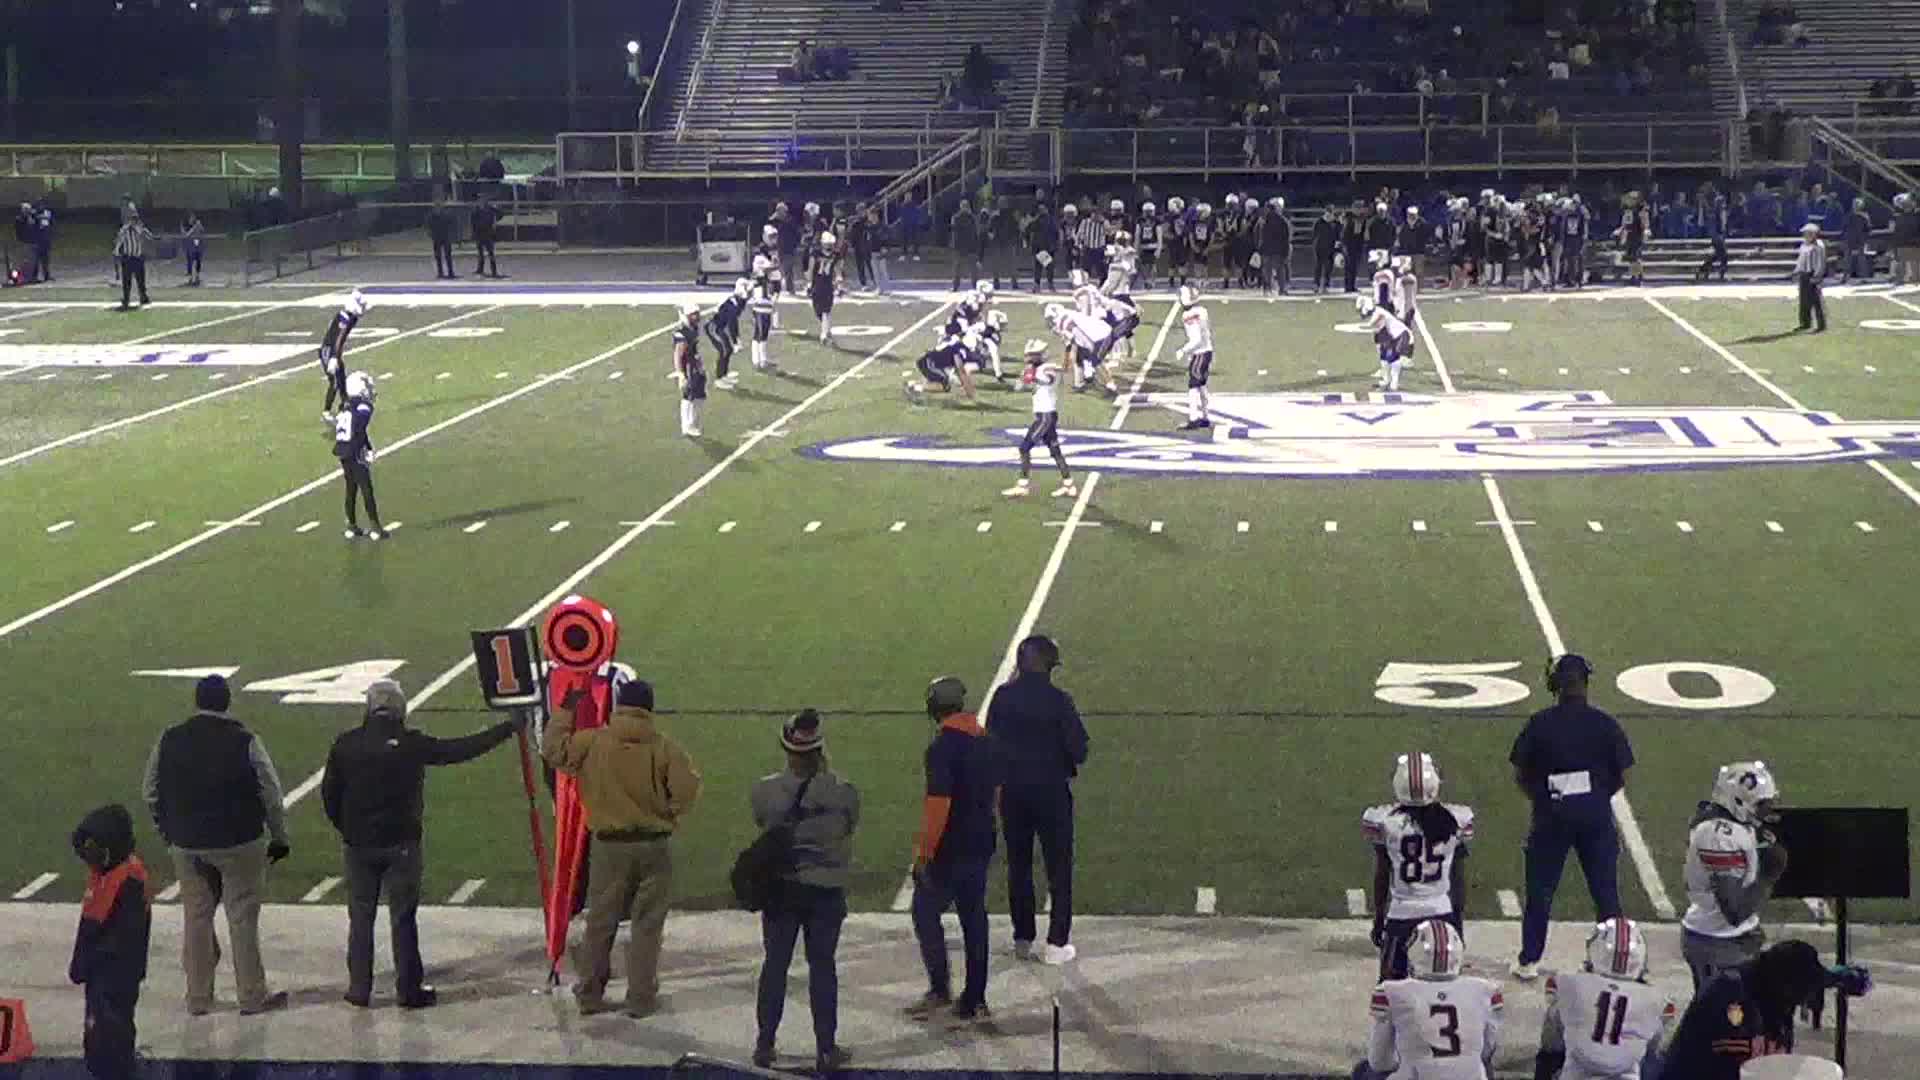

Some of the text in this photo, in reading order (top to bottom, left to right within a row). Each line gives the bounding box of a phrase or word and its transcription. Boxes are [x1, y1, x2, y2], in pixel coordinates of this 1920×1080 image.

[242, 657, 408, 699] 4
[490, 635, 520, 693] 1
[1400, 834, 1445, 882] 85
[1429, 1004, 1462, 1058] 3
[1591, 990, 1629, 1046] 11
